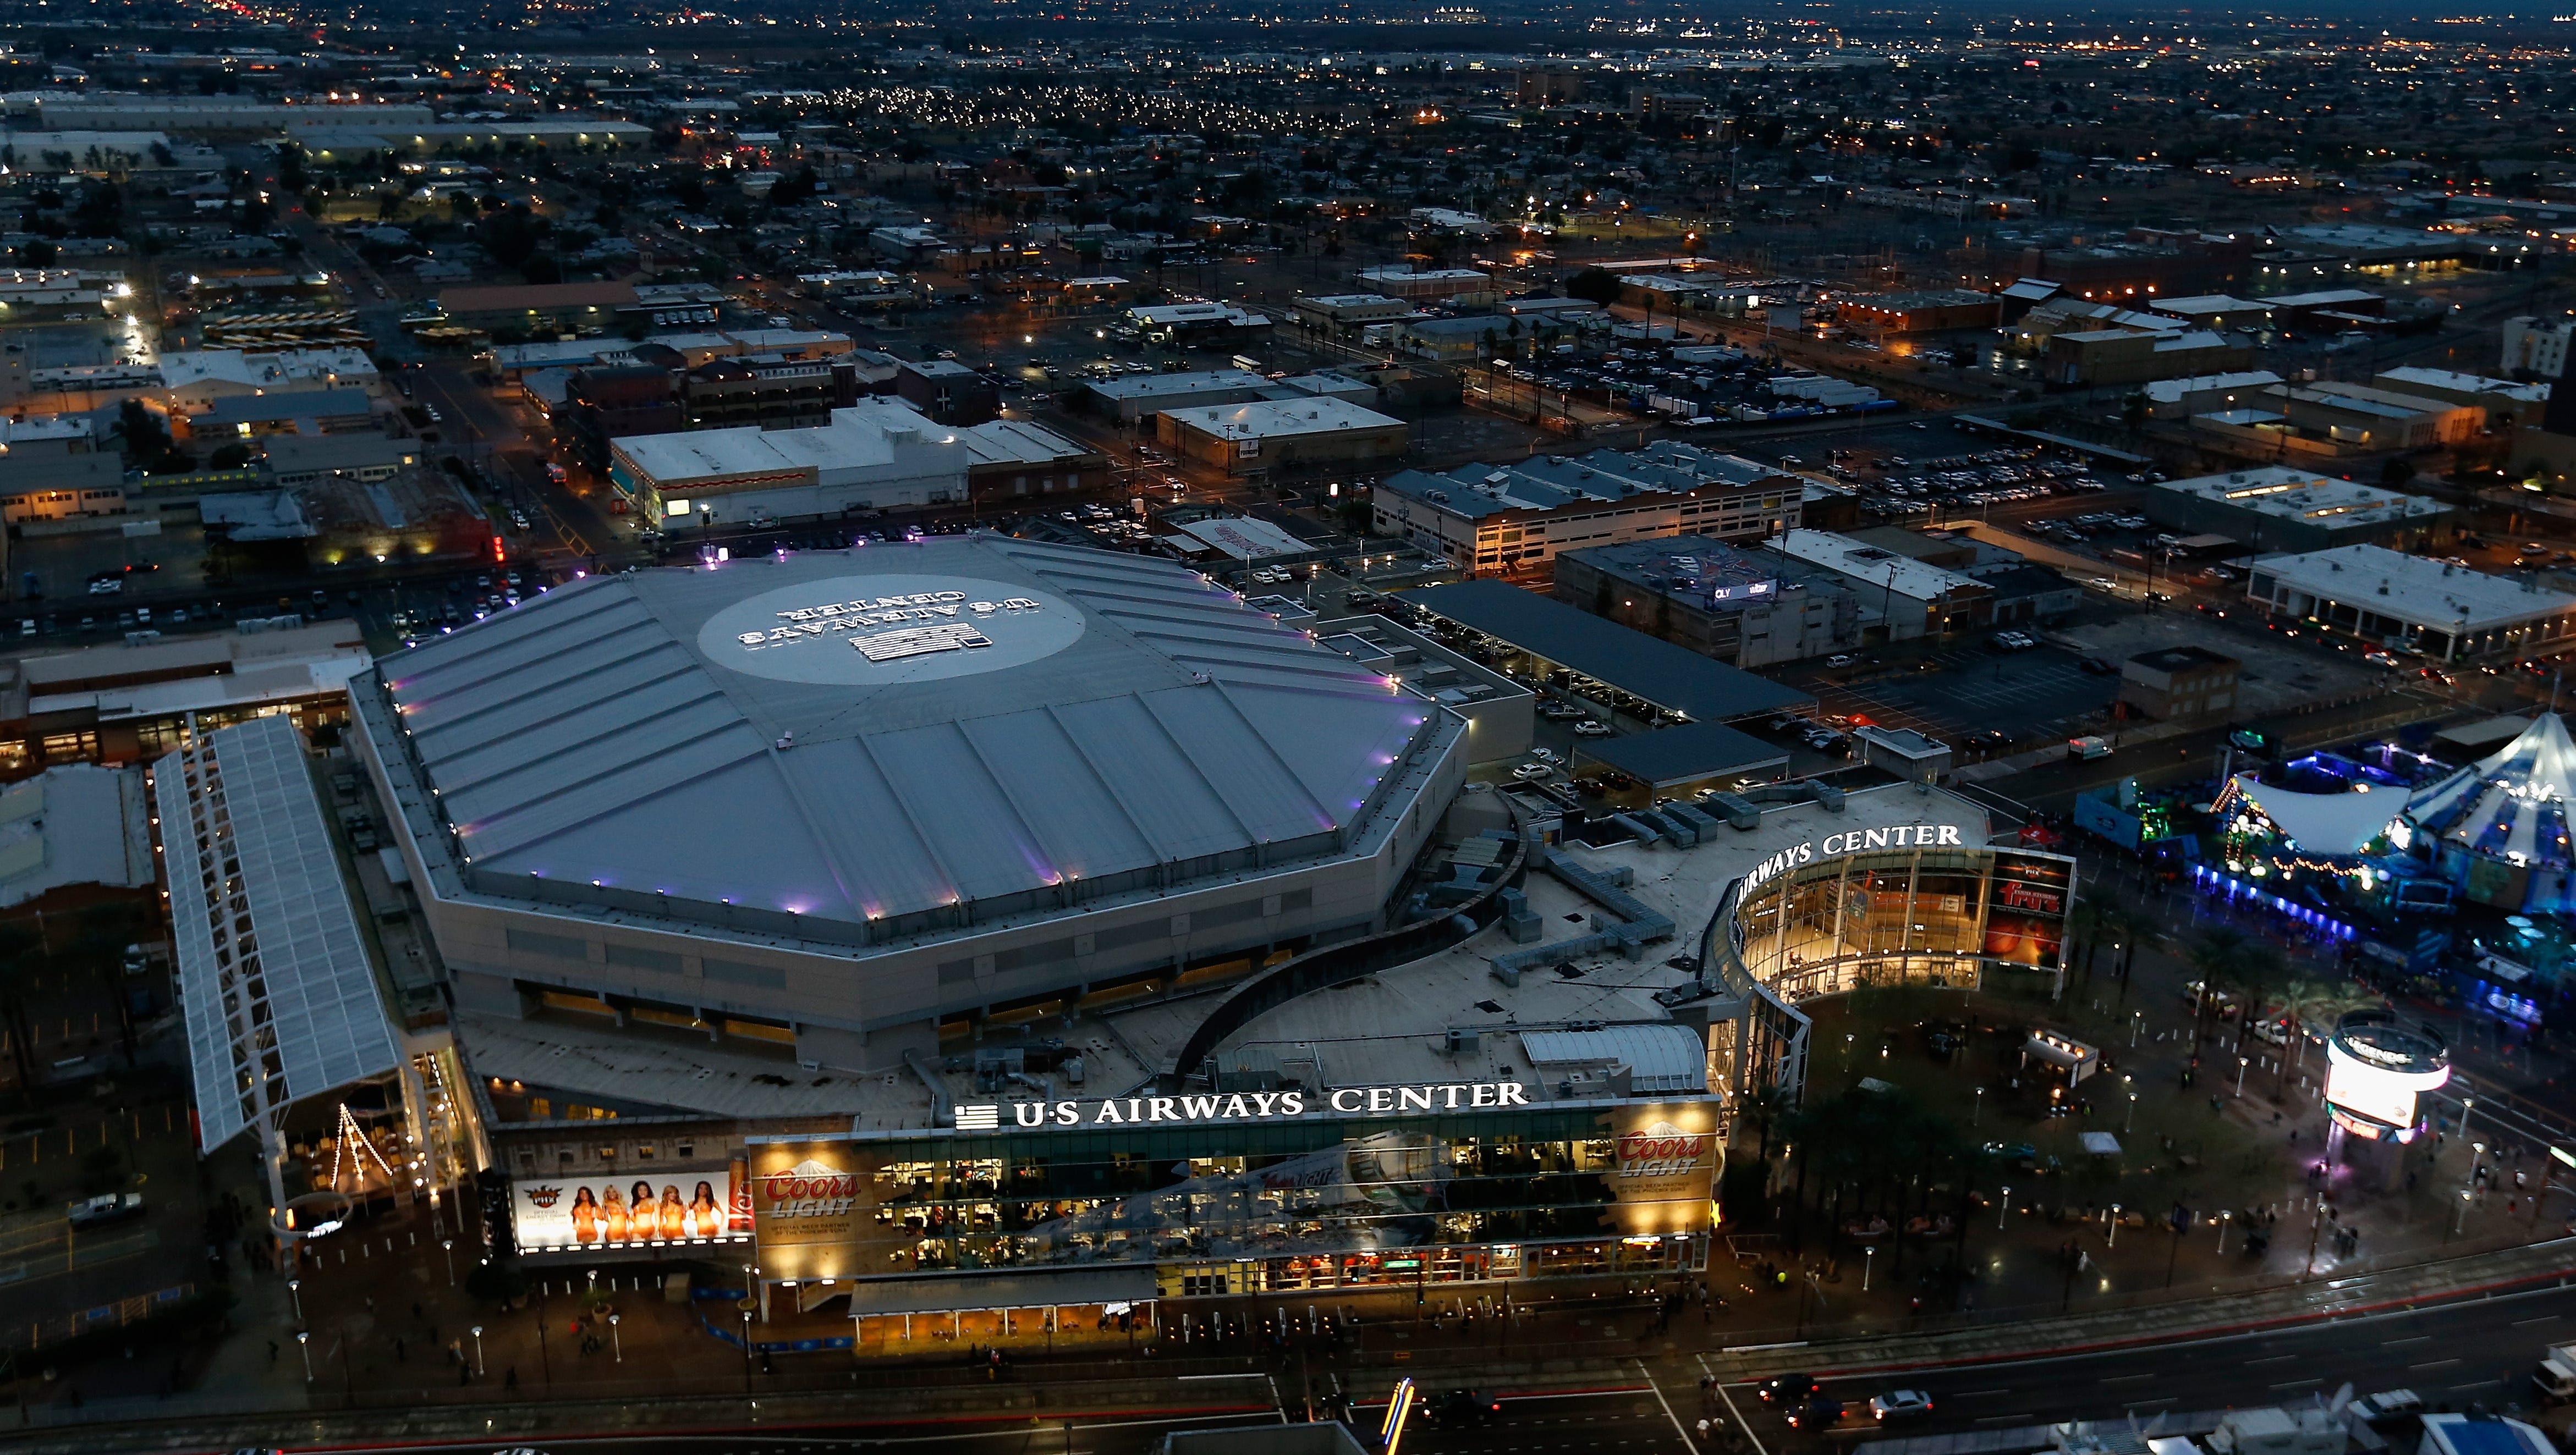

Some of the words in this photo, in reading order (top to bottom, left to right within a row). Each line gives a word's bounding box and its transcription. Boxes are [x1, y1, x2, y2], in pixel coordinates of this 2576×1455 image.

[775, 591, 966, 621] CENTER
[738, 604, 960, 644] AIRWAYS
[1735, 842, 1811, 913] AIRWAYS
[1822, 825, 1962, 855] CENTER
[1998, 881, 2059, 913] fry's
[1094, 1092, 1304, 1124] AIRWAYS
[1331, 1082, 1529, 1112] CENTER
[1618, 1130, 1705, 1161] Coors
[1619, 1158, 1698, 1178] LIGHT
[764, 1170, 861, 1201] Coors
[771, 1197, 855, 1219] LIGHT
